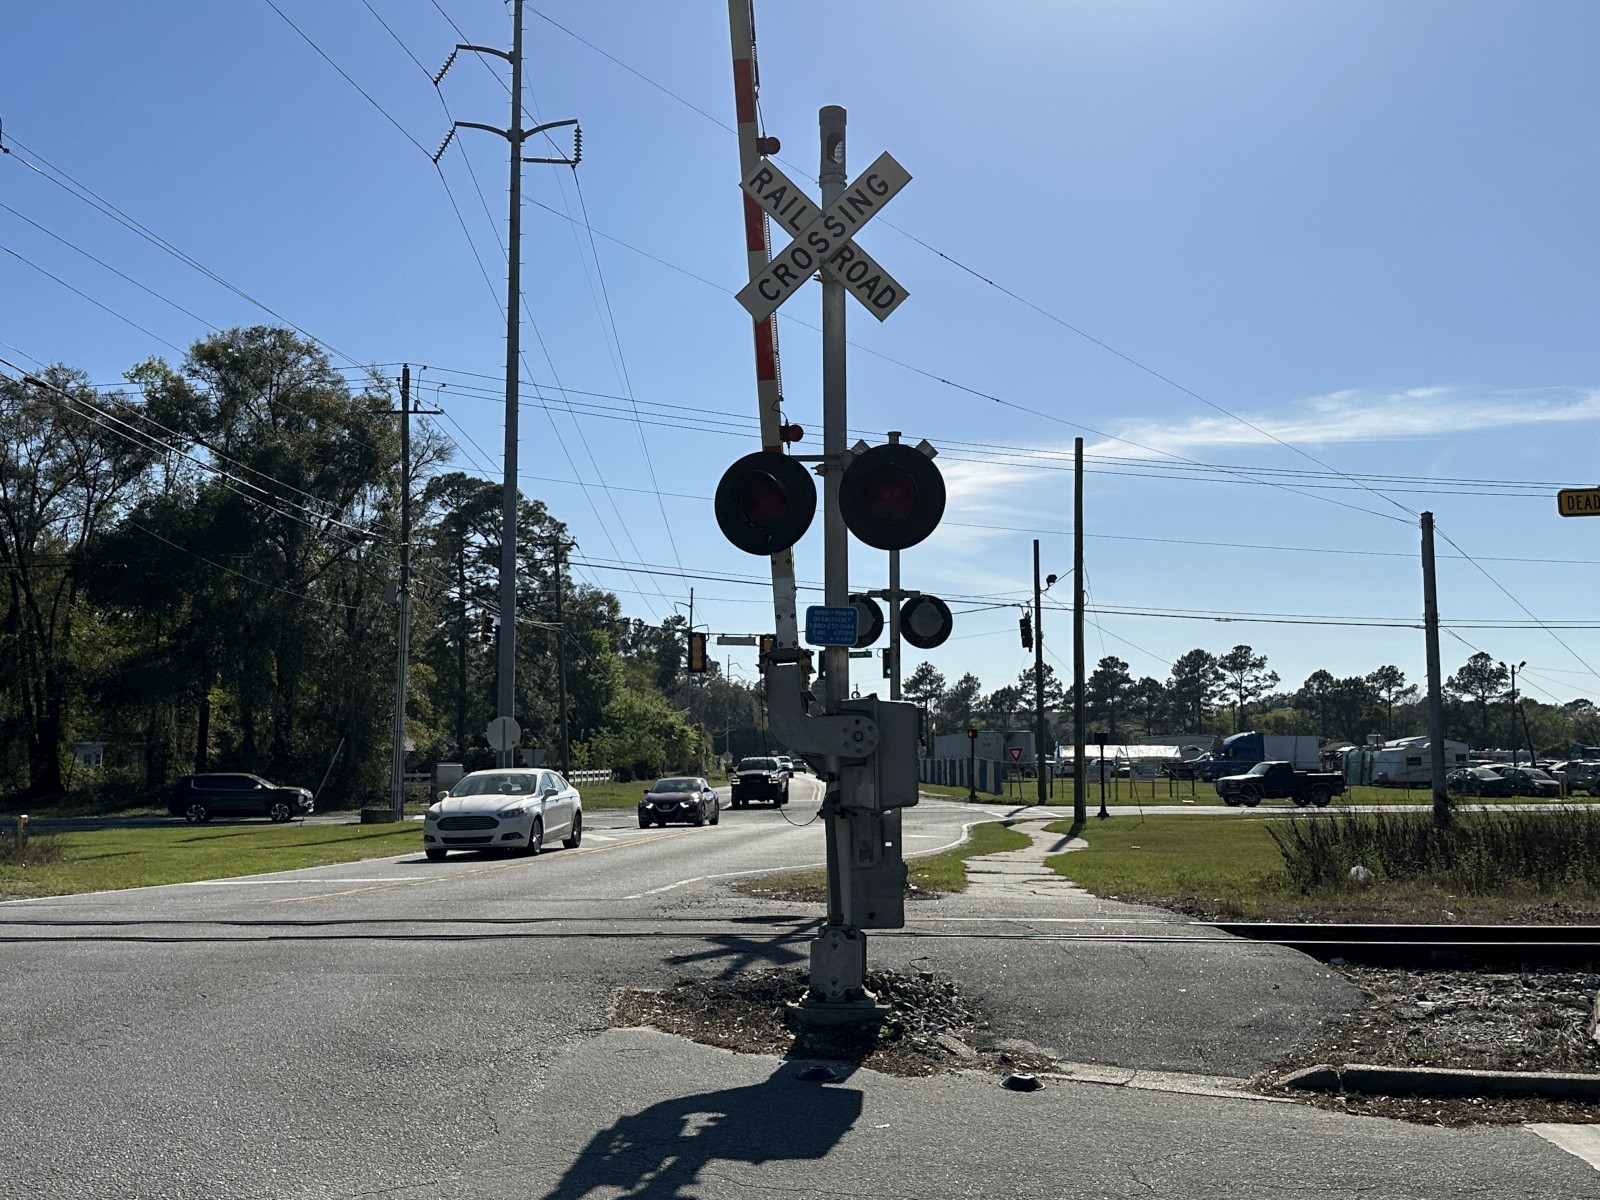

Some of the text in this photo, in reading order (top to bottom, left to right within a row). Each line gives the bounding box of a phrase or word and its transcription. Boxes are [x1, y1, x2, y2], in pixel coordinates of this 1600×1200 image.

[749, 167, 808, 232] RAIL
[758, 174, 889, 301] CROSSING
[830, 245, 897, 308] ROAD
[1567, 495, 1600, 510] DEAD
